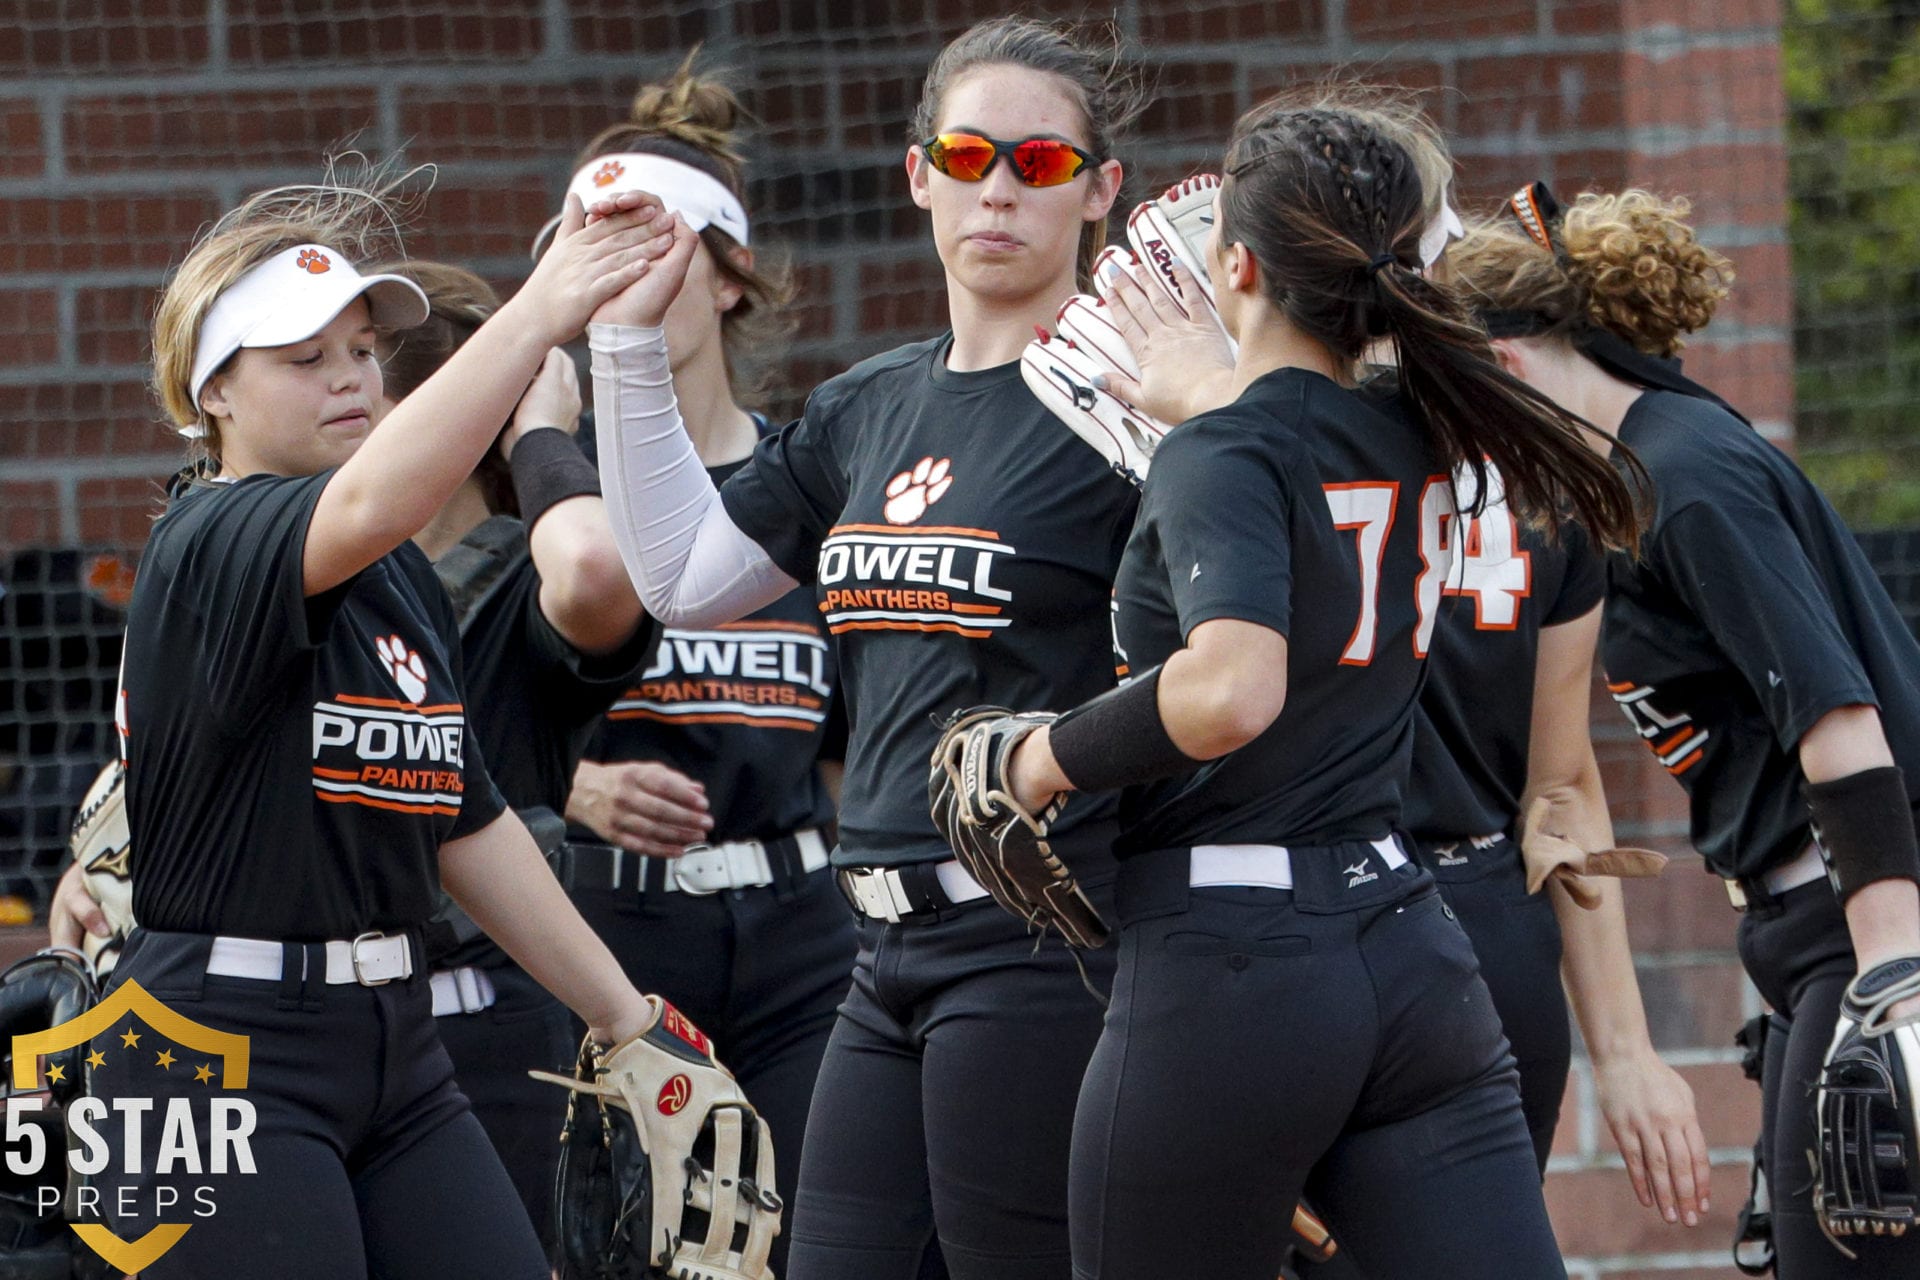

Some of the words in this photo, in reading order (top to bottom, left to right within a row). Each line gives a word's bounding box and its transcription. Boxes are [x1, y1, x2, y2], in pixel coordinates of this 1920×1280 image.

[818, 545, 1012, 602] OWELL
[826, 588, 951, 611] PANTHERS
[641, 679, 798, 704] PANTHERS
[312, 711, 464, 769] POWEL
[965, 731, 984, 799] Wilson
